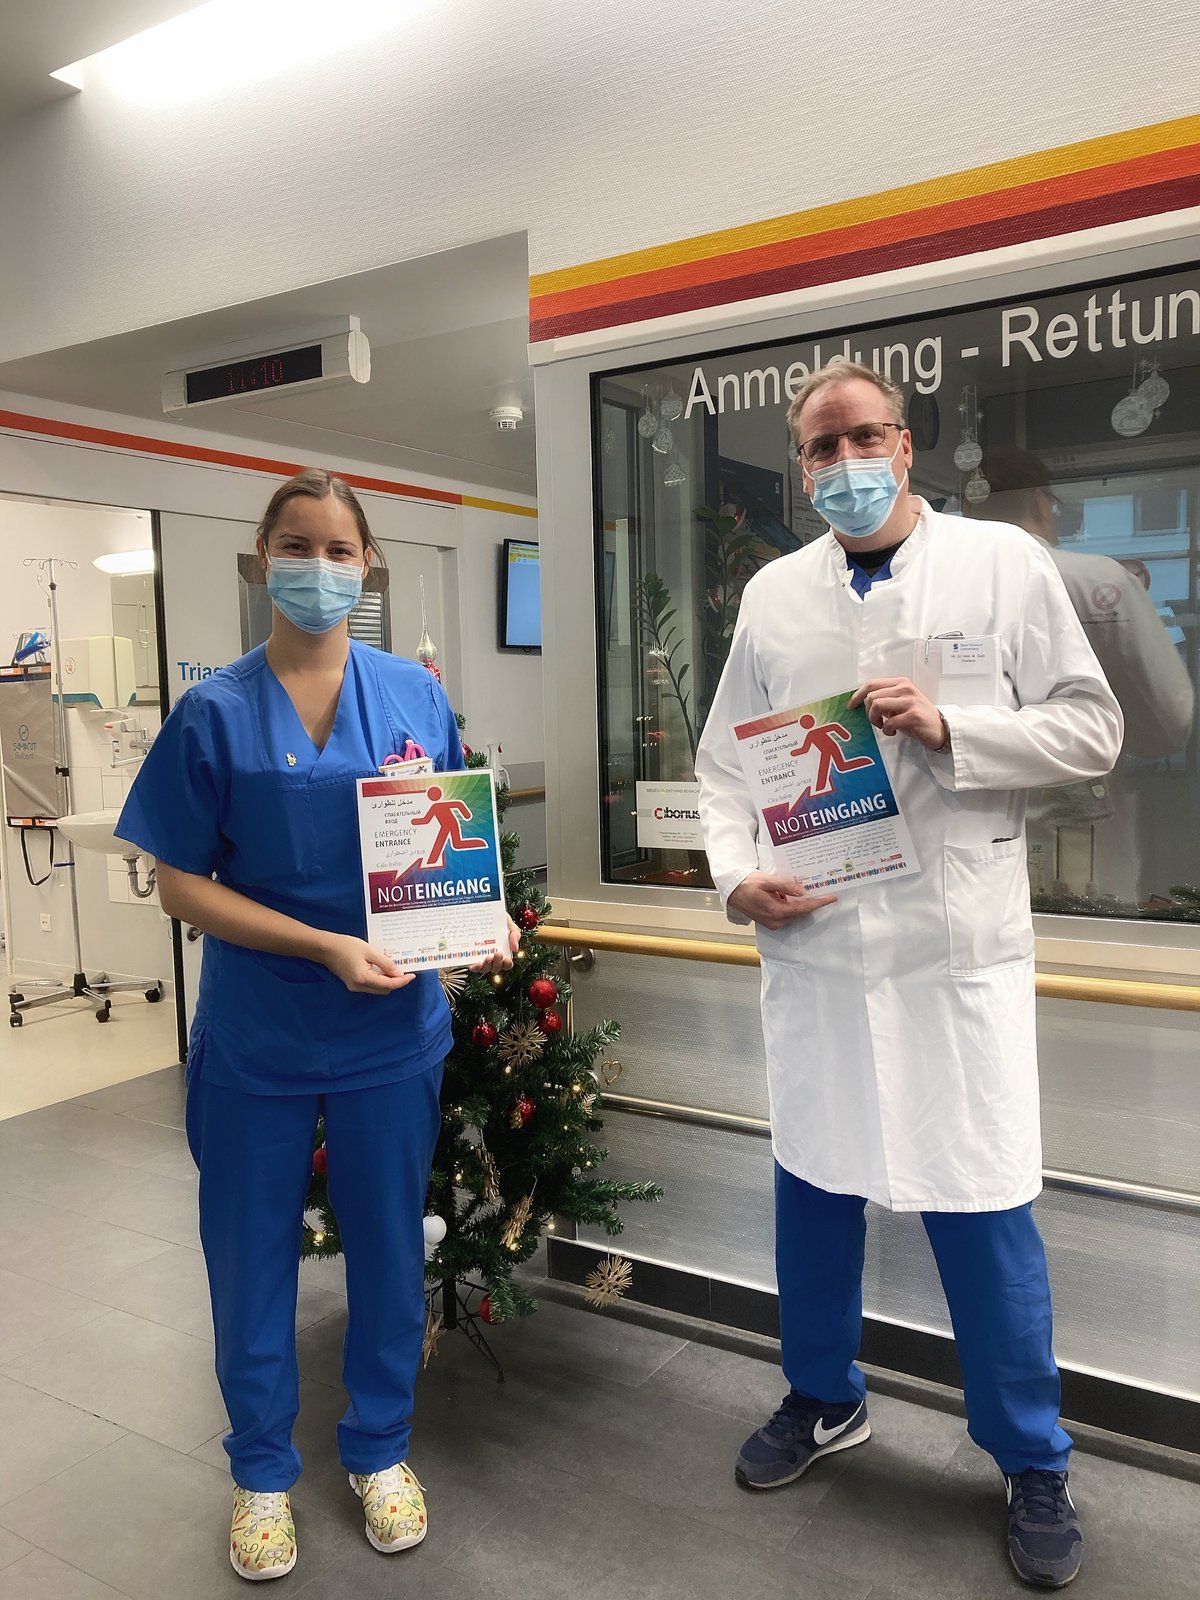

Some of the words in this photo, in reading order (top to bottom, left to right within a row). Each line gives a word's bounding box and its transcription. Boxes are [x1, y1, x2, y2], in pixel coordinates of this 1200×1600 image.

[1001, 288, 1200, 368] Rettun
[177, 661, 224, 681] Tria
[758, 760, 799, 777] EMERGENCY
[761, 769, 797, 785] ENTRANCE
[774, 792, 887, 836] NOTEINGANG
[374, 828, 417, 839] EMERGENCY
[375, 838, 412, 848] ENTRANCE
[377, 876, 491, 904] NOTEINGANG
